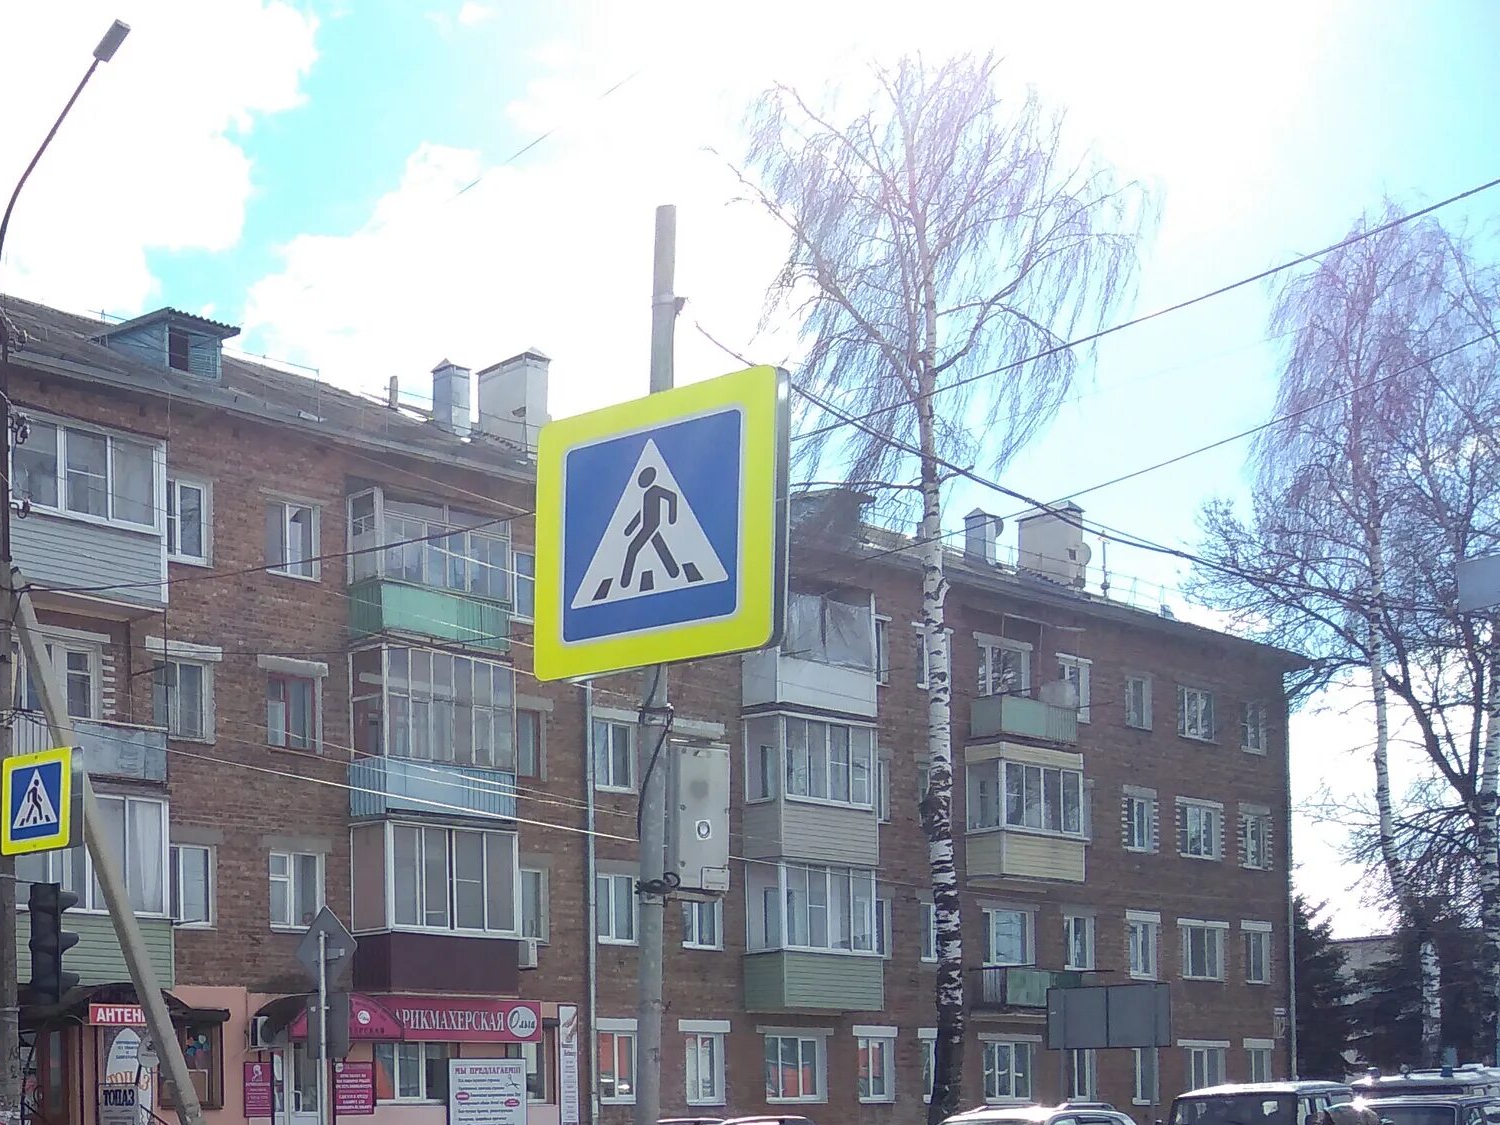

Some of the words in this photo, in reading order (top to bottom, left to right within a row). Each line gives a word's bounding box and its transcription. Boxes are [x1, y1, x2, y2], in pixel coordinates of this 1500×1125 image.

[395, 1009, 505, 1031] РИКМАХЕРСКАЯ
[454, 1067, 467, 1075] МЫ
[102, 1089, 136, 1107] ТОПАЗ
